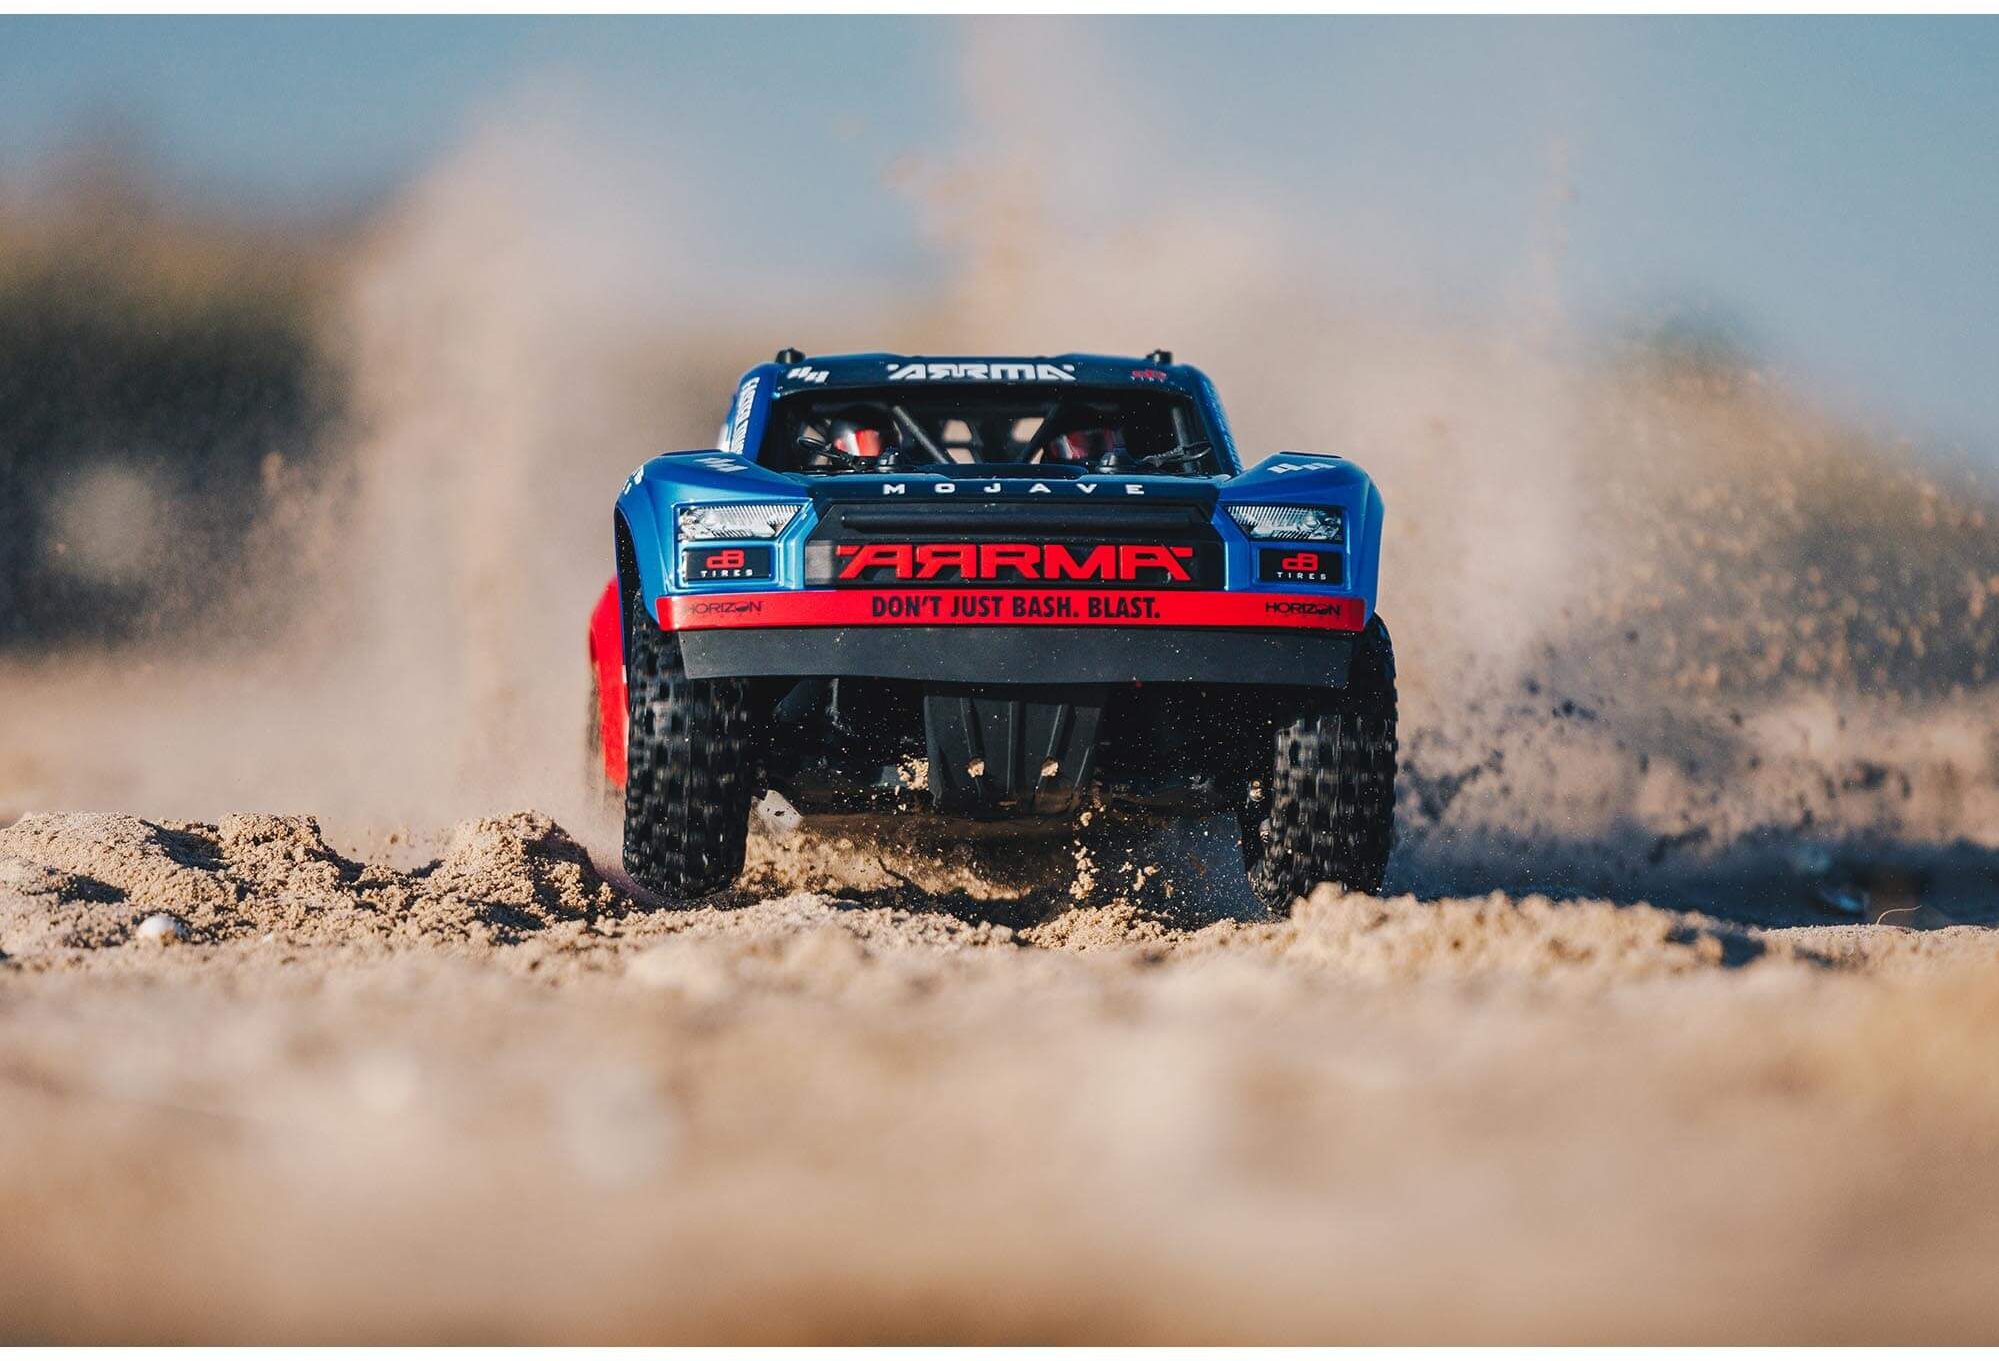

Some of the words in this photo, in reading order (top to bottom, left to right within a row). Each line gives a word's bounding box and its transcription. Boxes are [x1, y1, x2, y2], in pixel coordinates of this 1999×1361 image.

[887, 363, 1076, 380] ARRMA
[883, 483, 1145, 495] MOJAVE
[836, 544, 1193, 581] ARRMA
[701, 569, 753, 578] TIRES
[1276, 571, 1327, 580] TIRES
[872, 595, 943, 618] DON'T
[950, 595, 1003, 618] JUST
[1012, 596, 1079, 618] BASH.
[1087, 596, 1161, 619] BLAST.
[1265, 601, 1341, 615] HORIZON
